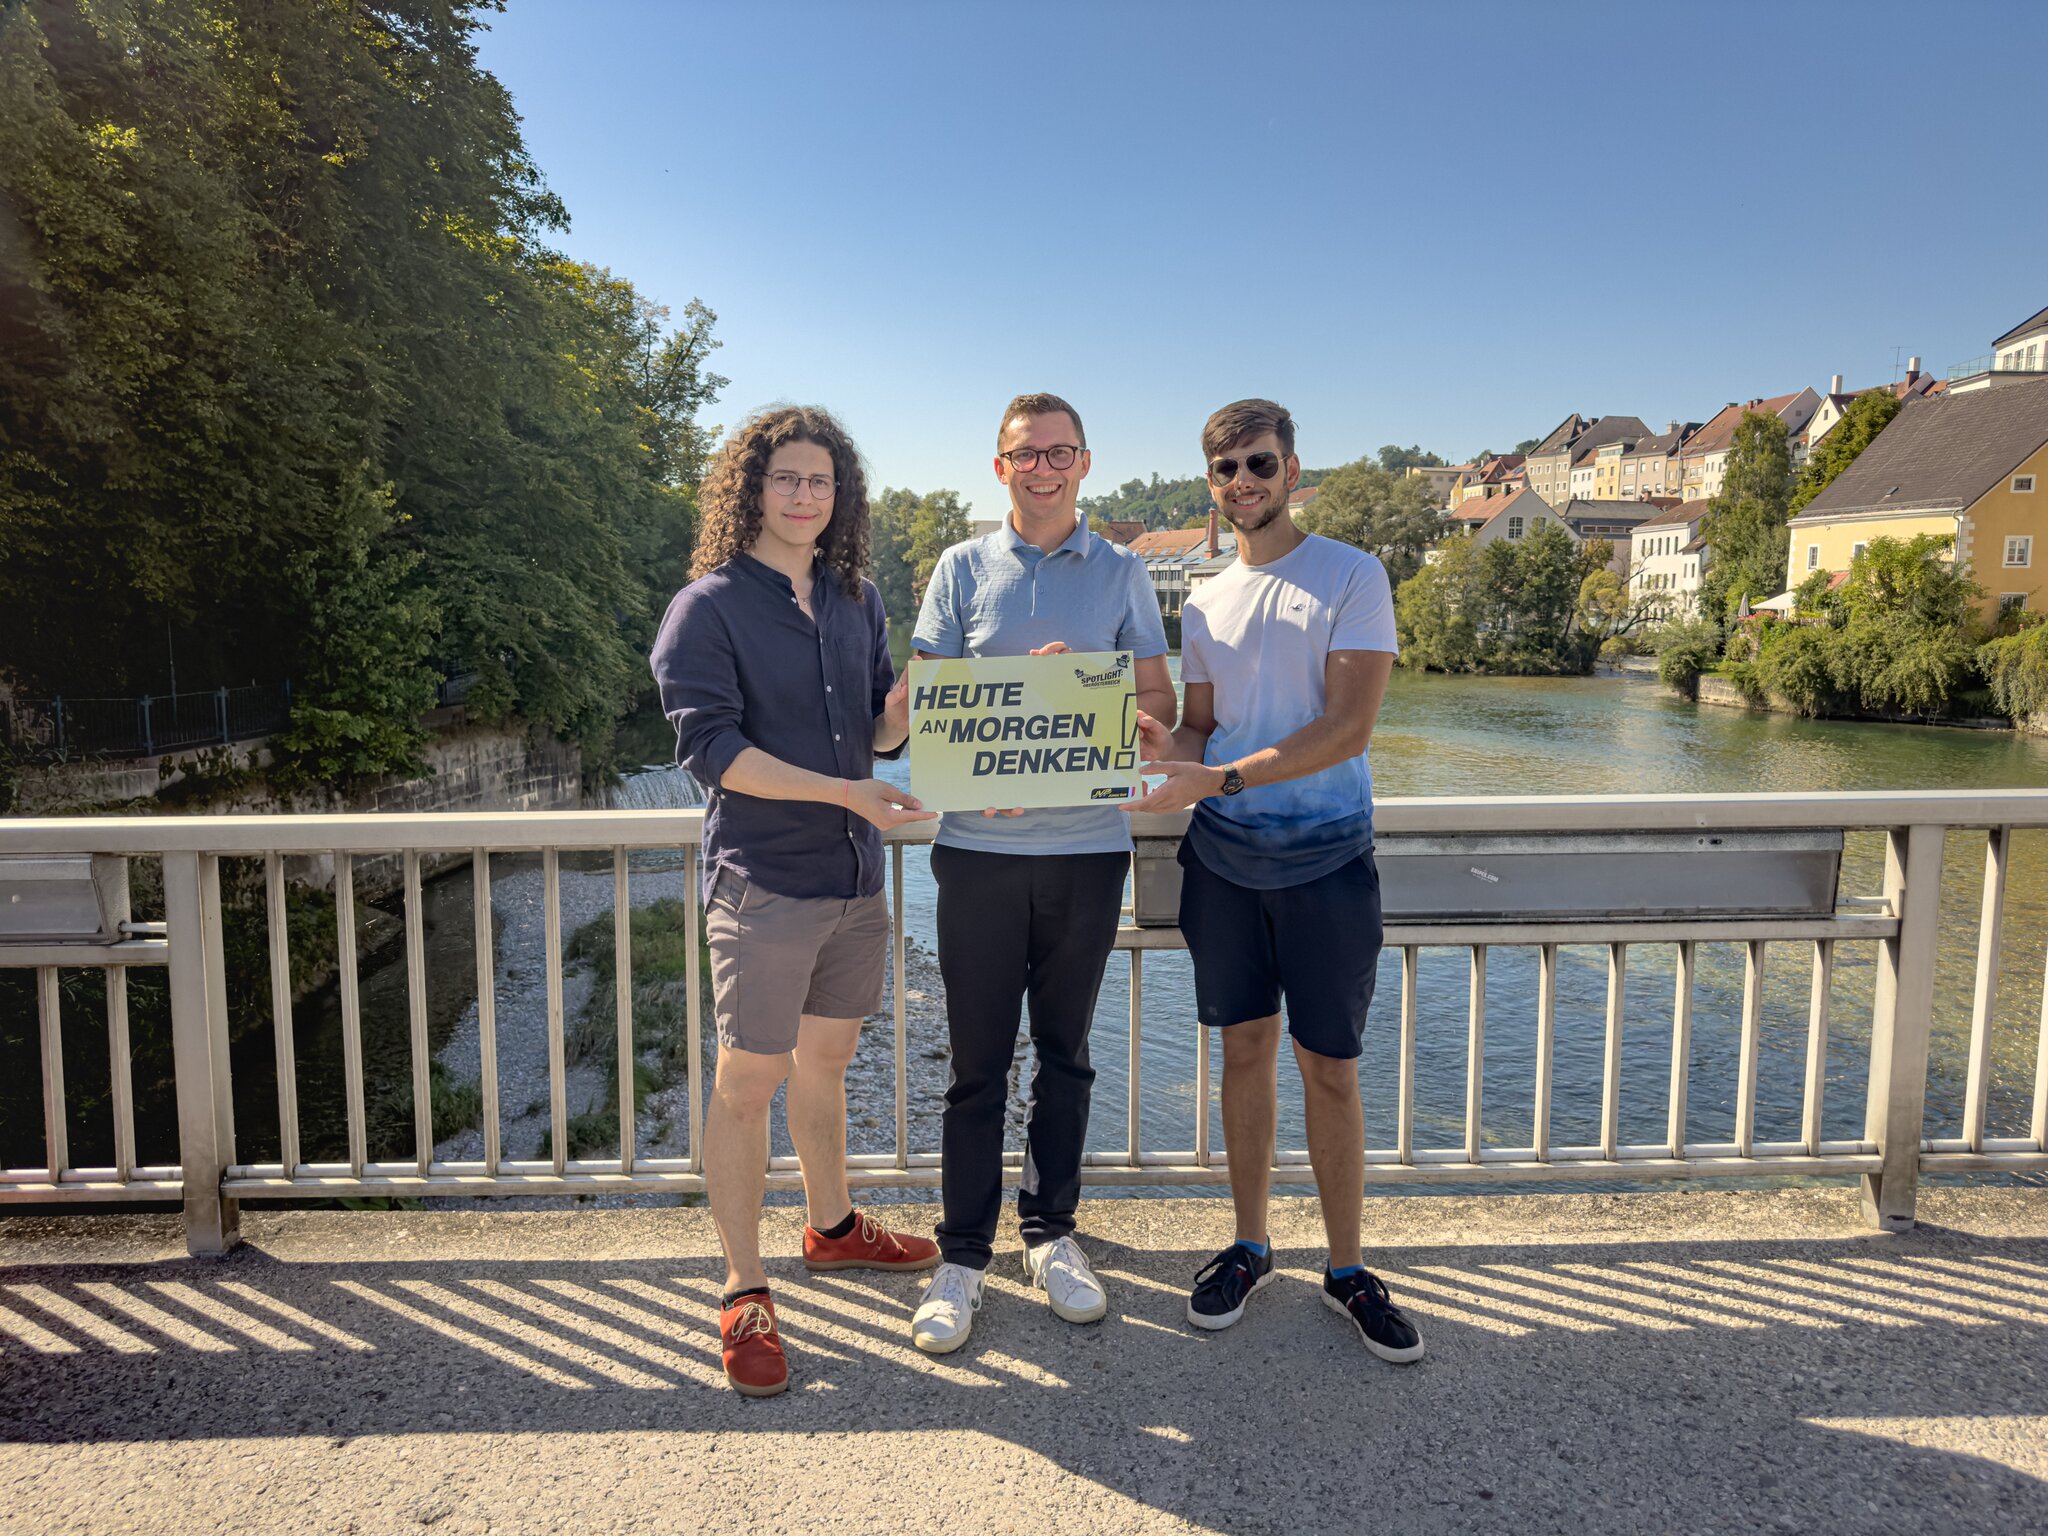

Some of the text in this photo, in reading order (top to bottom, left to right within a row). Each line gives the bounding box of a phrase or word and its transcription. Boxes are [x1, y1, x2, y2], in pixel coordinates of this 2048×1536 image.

[913, 682, 1024, 710] HEUTE
[919, 713, 1096, 743] AN MORGEN
